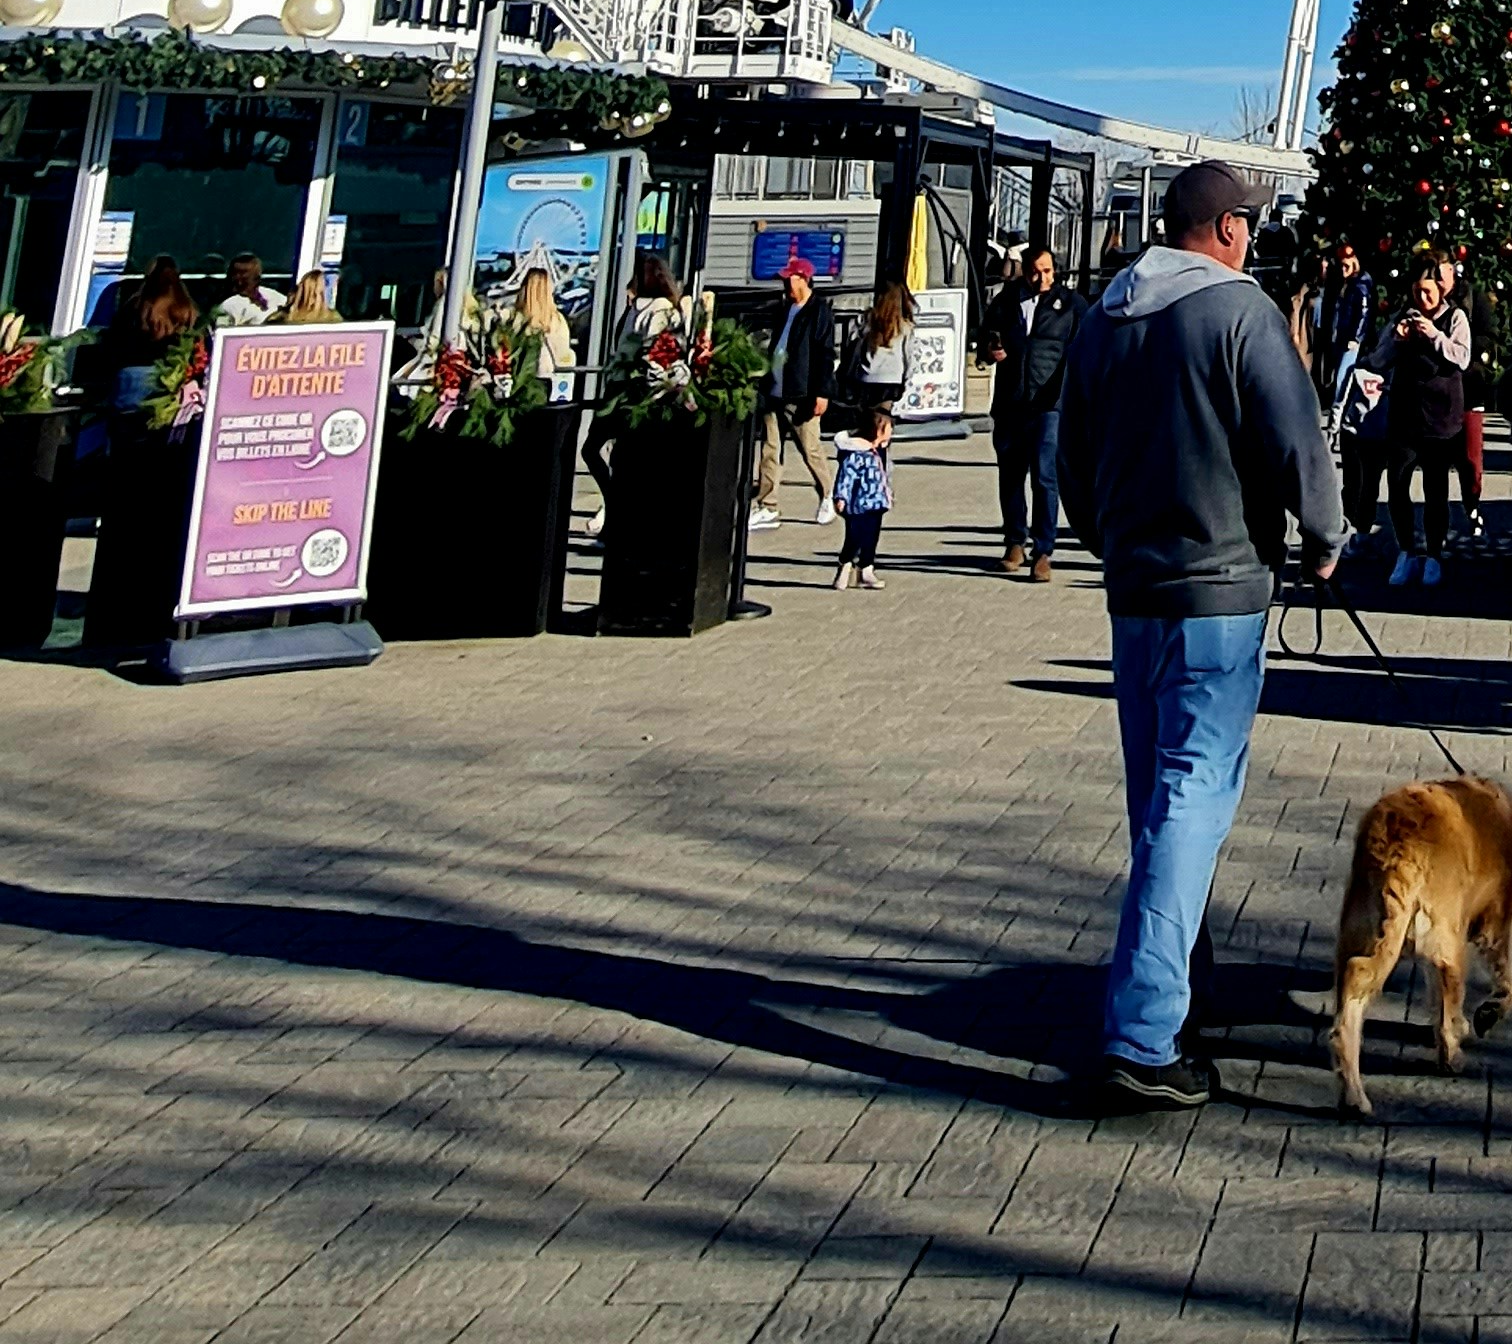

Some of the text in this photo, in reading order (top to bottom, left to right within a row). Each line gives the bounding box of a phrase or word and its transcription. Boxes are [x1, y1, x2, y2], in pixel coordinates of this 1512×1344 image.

[135, 96, 149, 137] 1
[346, 104, 361, 145] 2
[236, 342, 367, 372] ÉVITEZ LA FILE
[252, 370, 346, 399] D'ATTENTE
[232, 497, 333, 526] SKIP THE LINE
